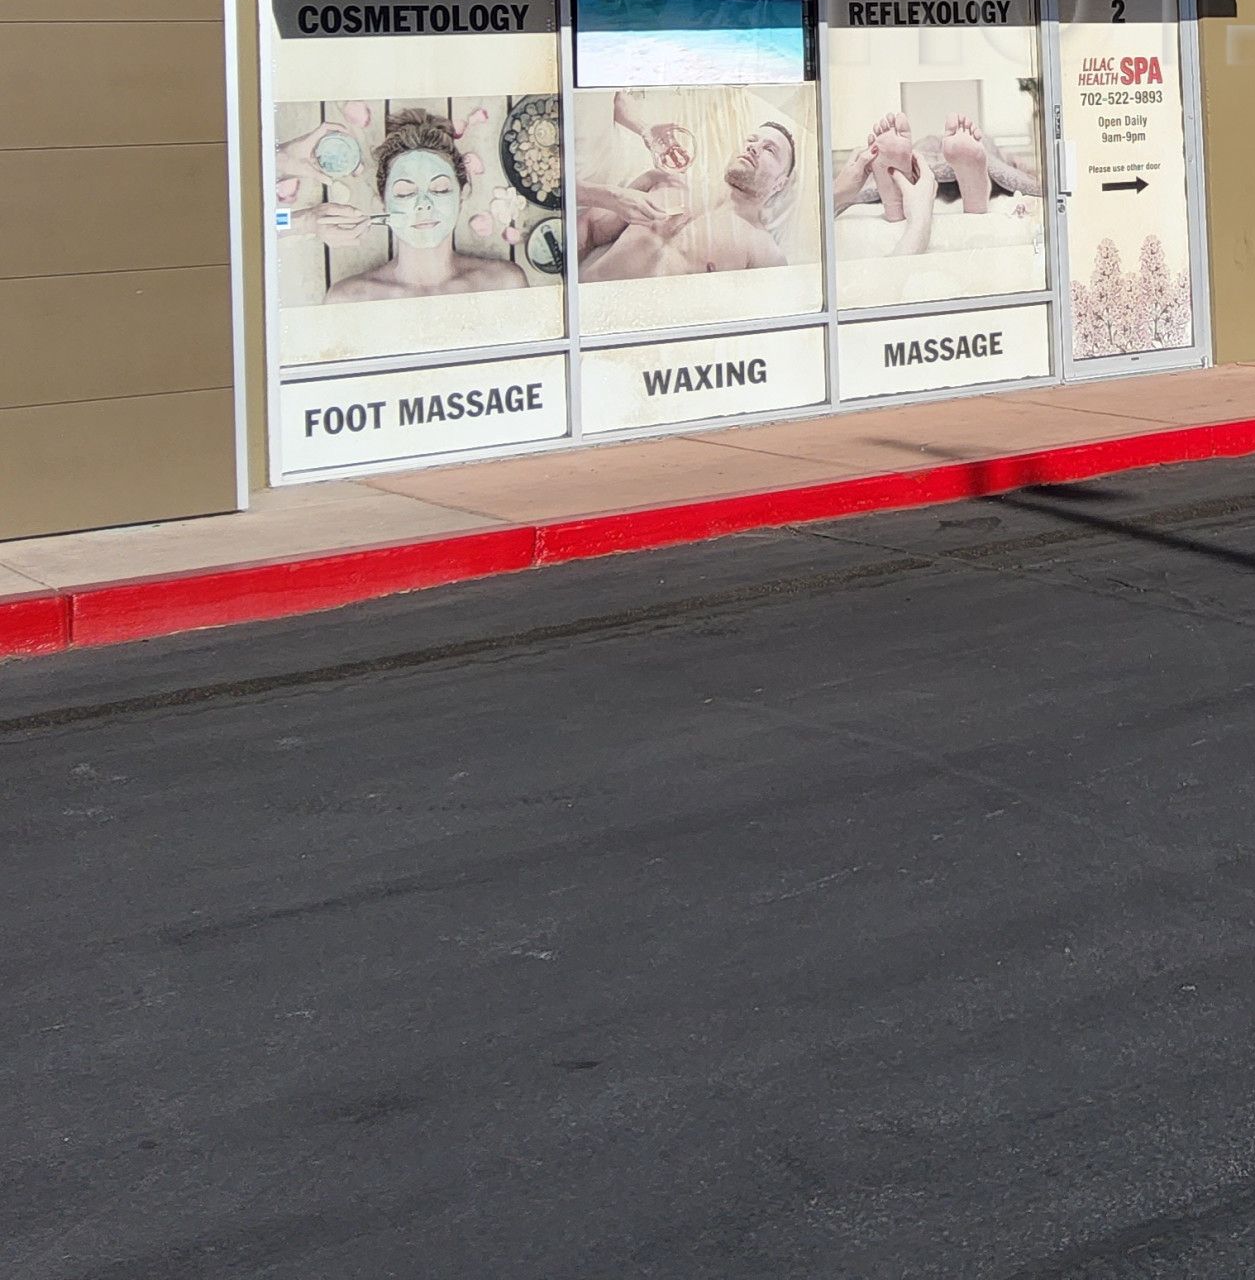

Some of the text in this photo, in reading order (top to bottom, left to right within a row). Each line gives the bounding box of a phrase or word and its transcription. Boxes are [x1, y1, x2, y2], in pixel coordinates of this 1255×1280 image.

[297, 4, 529, 33] COSMETOLOGY
[848, 0, 1011, 26] REFLEXOLOGY
[1111, 0, 1126, 23] 2
[1082, 57, 1115, 72] LILAC
[1120, 56, 1163, 85] SPA
[1078, 72, 1119, 86] HEALTH
[1080, 90, 1163, 106] 702-522-9893
[1098, 114, 1148, 129] Open Daily
[1101, 131, 1146, 143] 9am-9pm
[1088, 165, 1111, 174] Please
[1126, 163, 1144, 171] other
[1145, 162, 1161, 170] door
[884, 332, 1003, 368] MASSAGE
[643, 358, 768, 396] WAXING
[304, 383, 544, 437] FOOT MASSAGE
